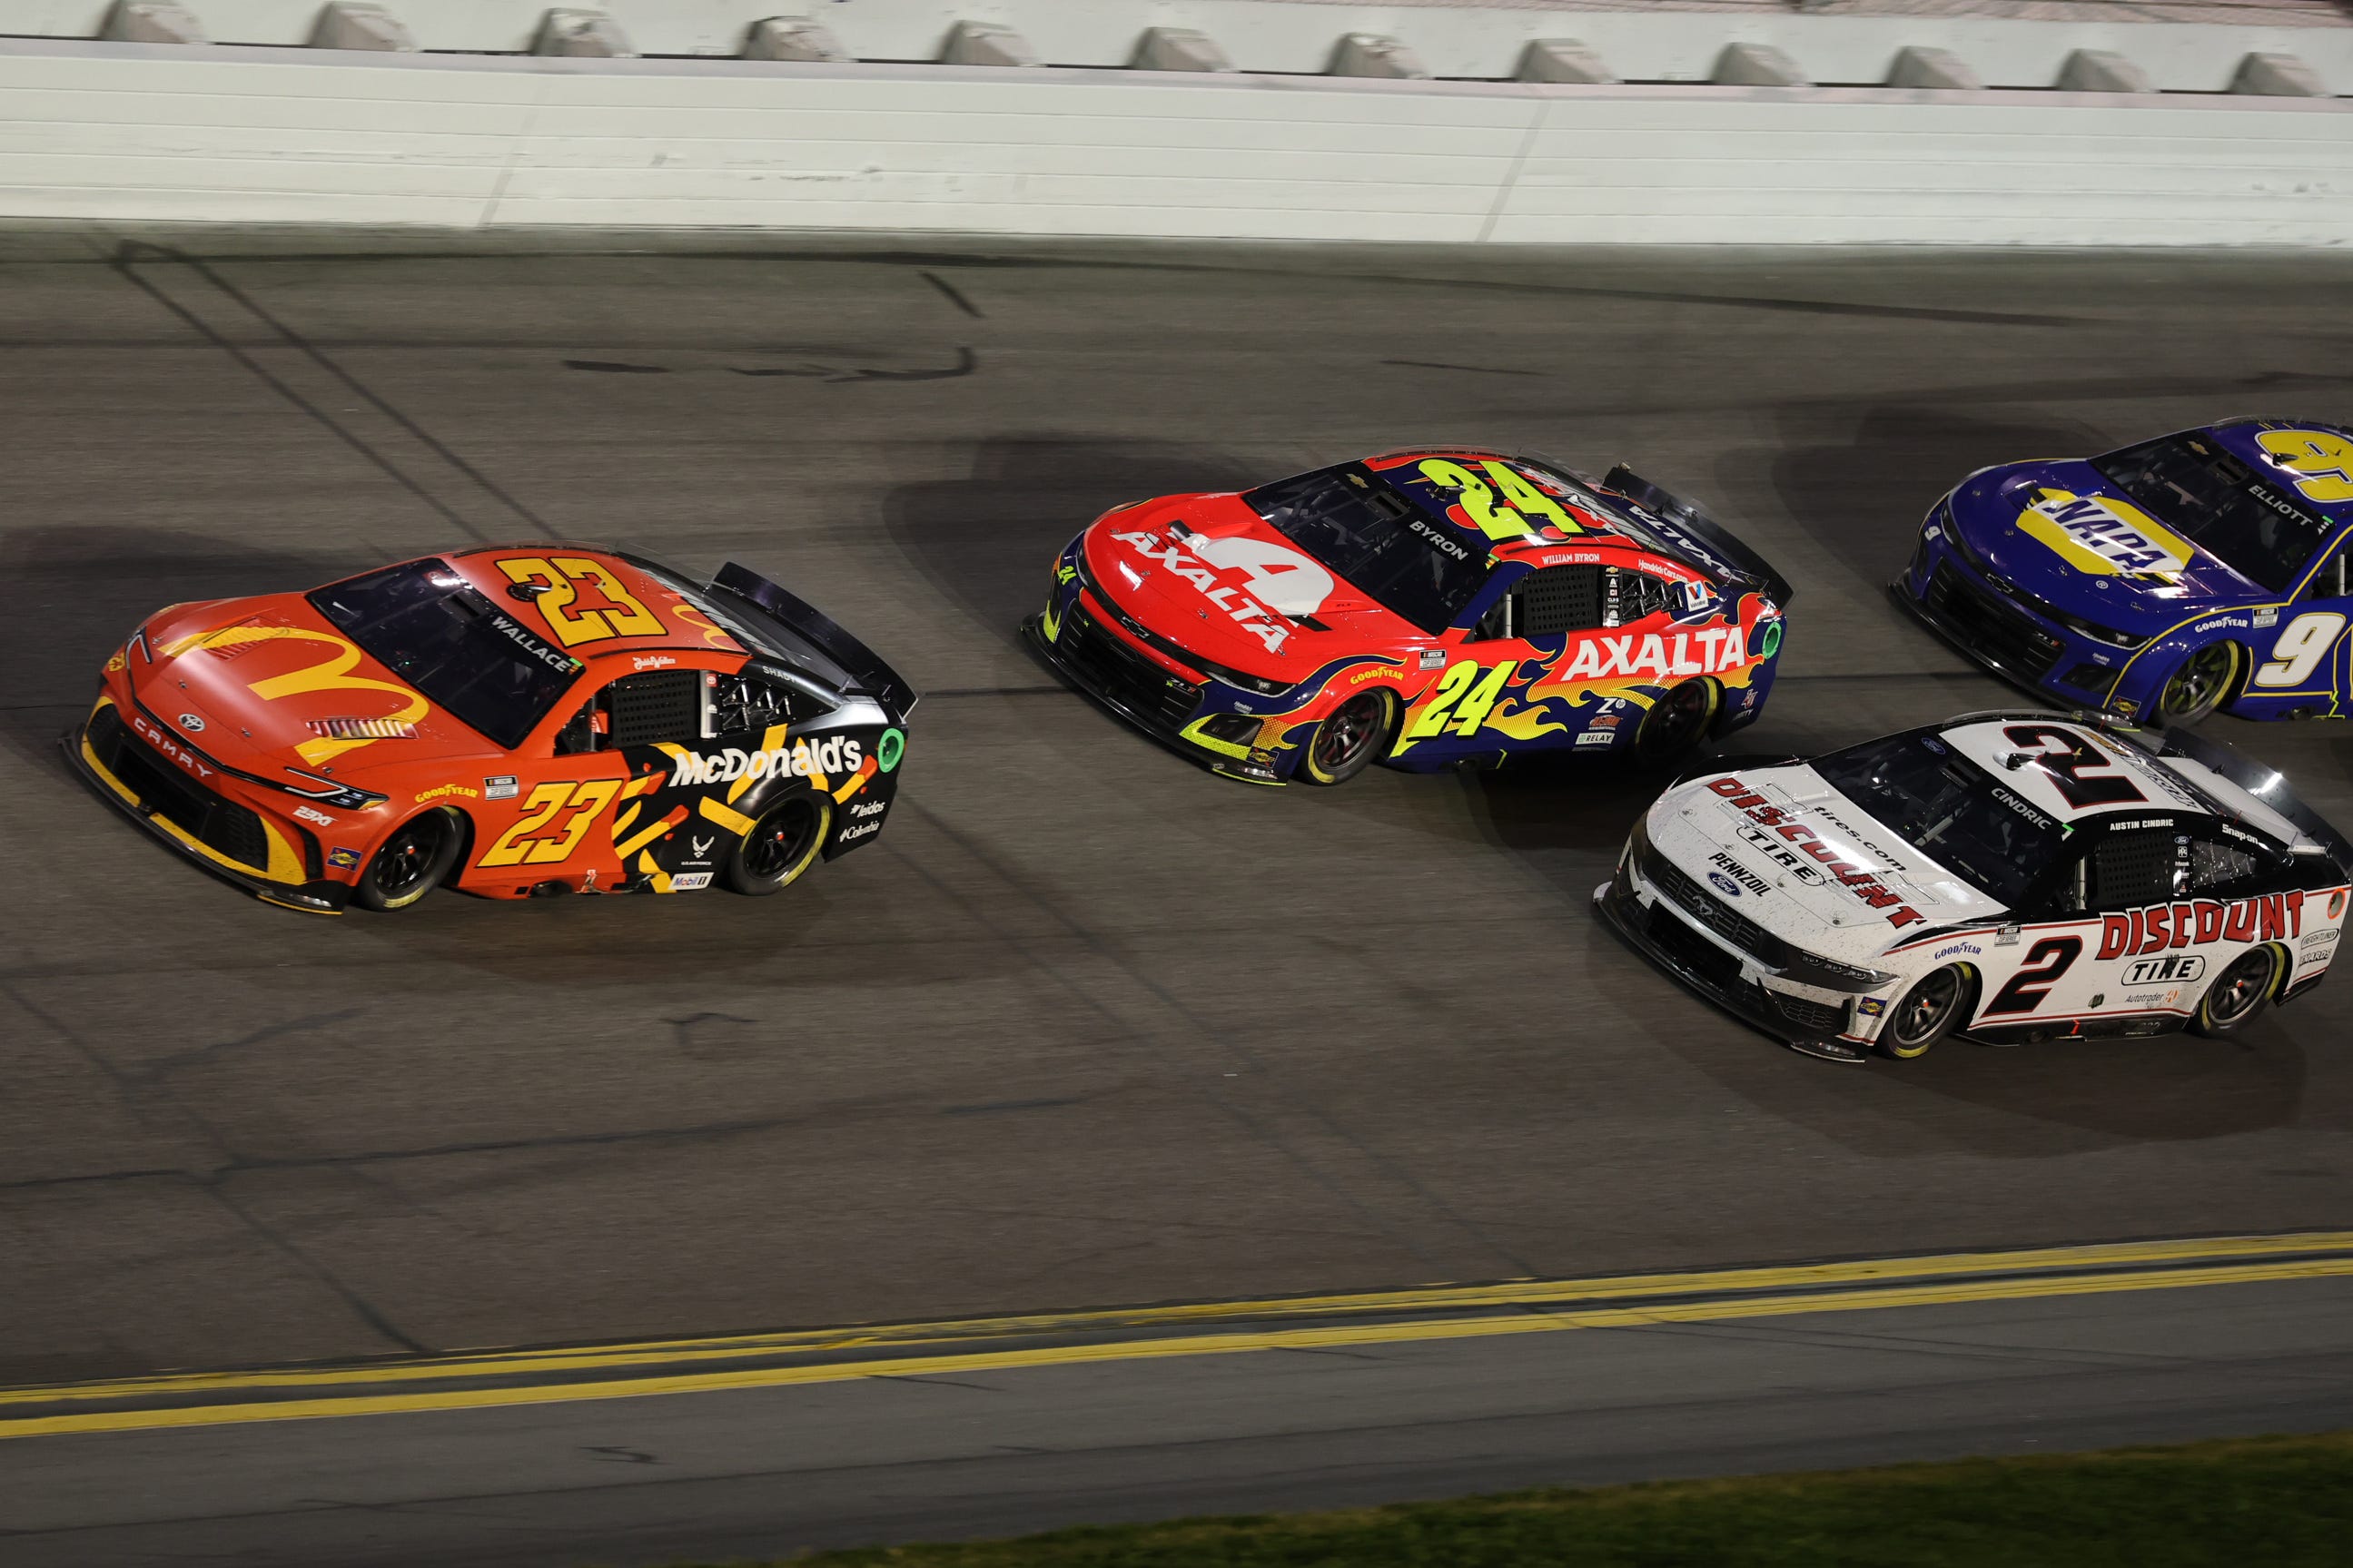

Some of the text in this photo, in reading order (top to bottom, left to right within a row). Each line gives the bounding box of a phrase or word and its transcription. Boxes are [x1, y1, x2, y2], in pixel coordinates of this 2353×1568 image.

[2255, 429, 2353, 503] 9
[1419, 459, 1584, 541] 24
[2249, 485, 2313, 526] ELLIOTT
[1409, 520, 1468, 560] BYRON
[1542, 553, 1600, 565] WILLIAM BYRON
[2042, 500, 2167, 570] NAPA
[1059, 566, 1076, 586] 24
[1111, 532, 1290, 654] AXALTA
[494, 557, 669, 649] 23
[2195, 616, 2248, 633] GOODYEAR
[491, 616, 571, 673] WALLACE
[1561, 626, 1745, 681] AXALTA
[2254, 612, 2347, 687] 9
[1350, 666, 1403, 685] GOODYEAR
[1407, 660, 1519, 740] 24
[133, 717, 213, 777] CAMRY
[668, 735, 862, 787] McDonald's
[2003, 725, 2149, 810] 2
[415, 784, 479, 803] GOODYEAR
[1991, 788, 2052, 830] CINDRIC
[474, 778, 624, 869] 23
[1814, 806, 1906, 872] tires.com
[2110, 819, 2174, 831] AUSTIN CINDRIC
[2222, 823, 2259, 845] Snap-on
[1707, 778, 1927, 929] DISCOUNT
[1708, 852, 1771, 897] PENNZOIL
[1748, 830, 1816, 880] TIRE
[676, 876, 698, 886] Mobil
[1711, 874, 1739, 894] Ford
[1934, 942, 1982, 960] GOODYEAR
[2095, 890, 2303, 960] DISCOUNT
[1979, 934, 2082, 1019] 2
[2125, 992, 2165, 1002] Autotrader
